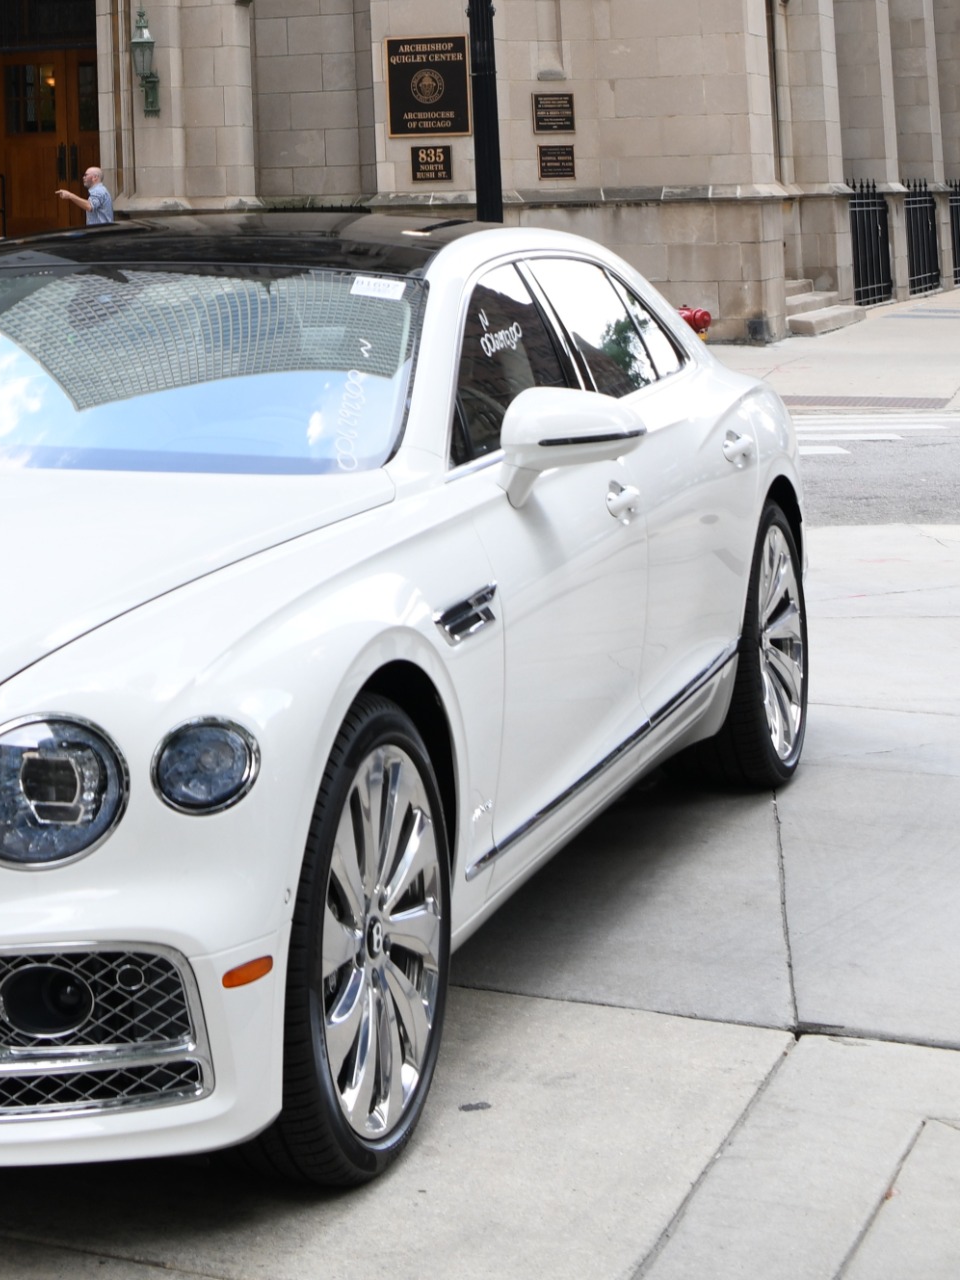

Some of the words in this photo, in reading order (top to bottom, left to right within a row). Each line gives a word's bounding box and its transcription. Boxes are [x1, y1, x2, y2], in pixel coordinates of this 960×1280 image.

[398, 42, 454, 52] ARCHBISHOP
[390, 54, 428, 64] QUIGLEY
[428, 52, 463, 62] CENTER
[403, 111, 454, 120] ARCHDIOCESE
[418, 120, 452, 128] CHICAGO
[418, 148, 444, 163] 835
